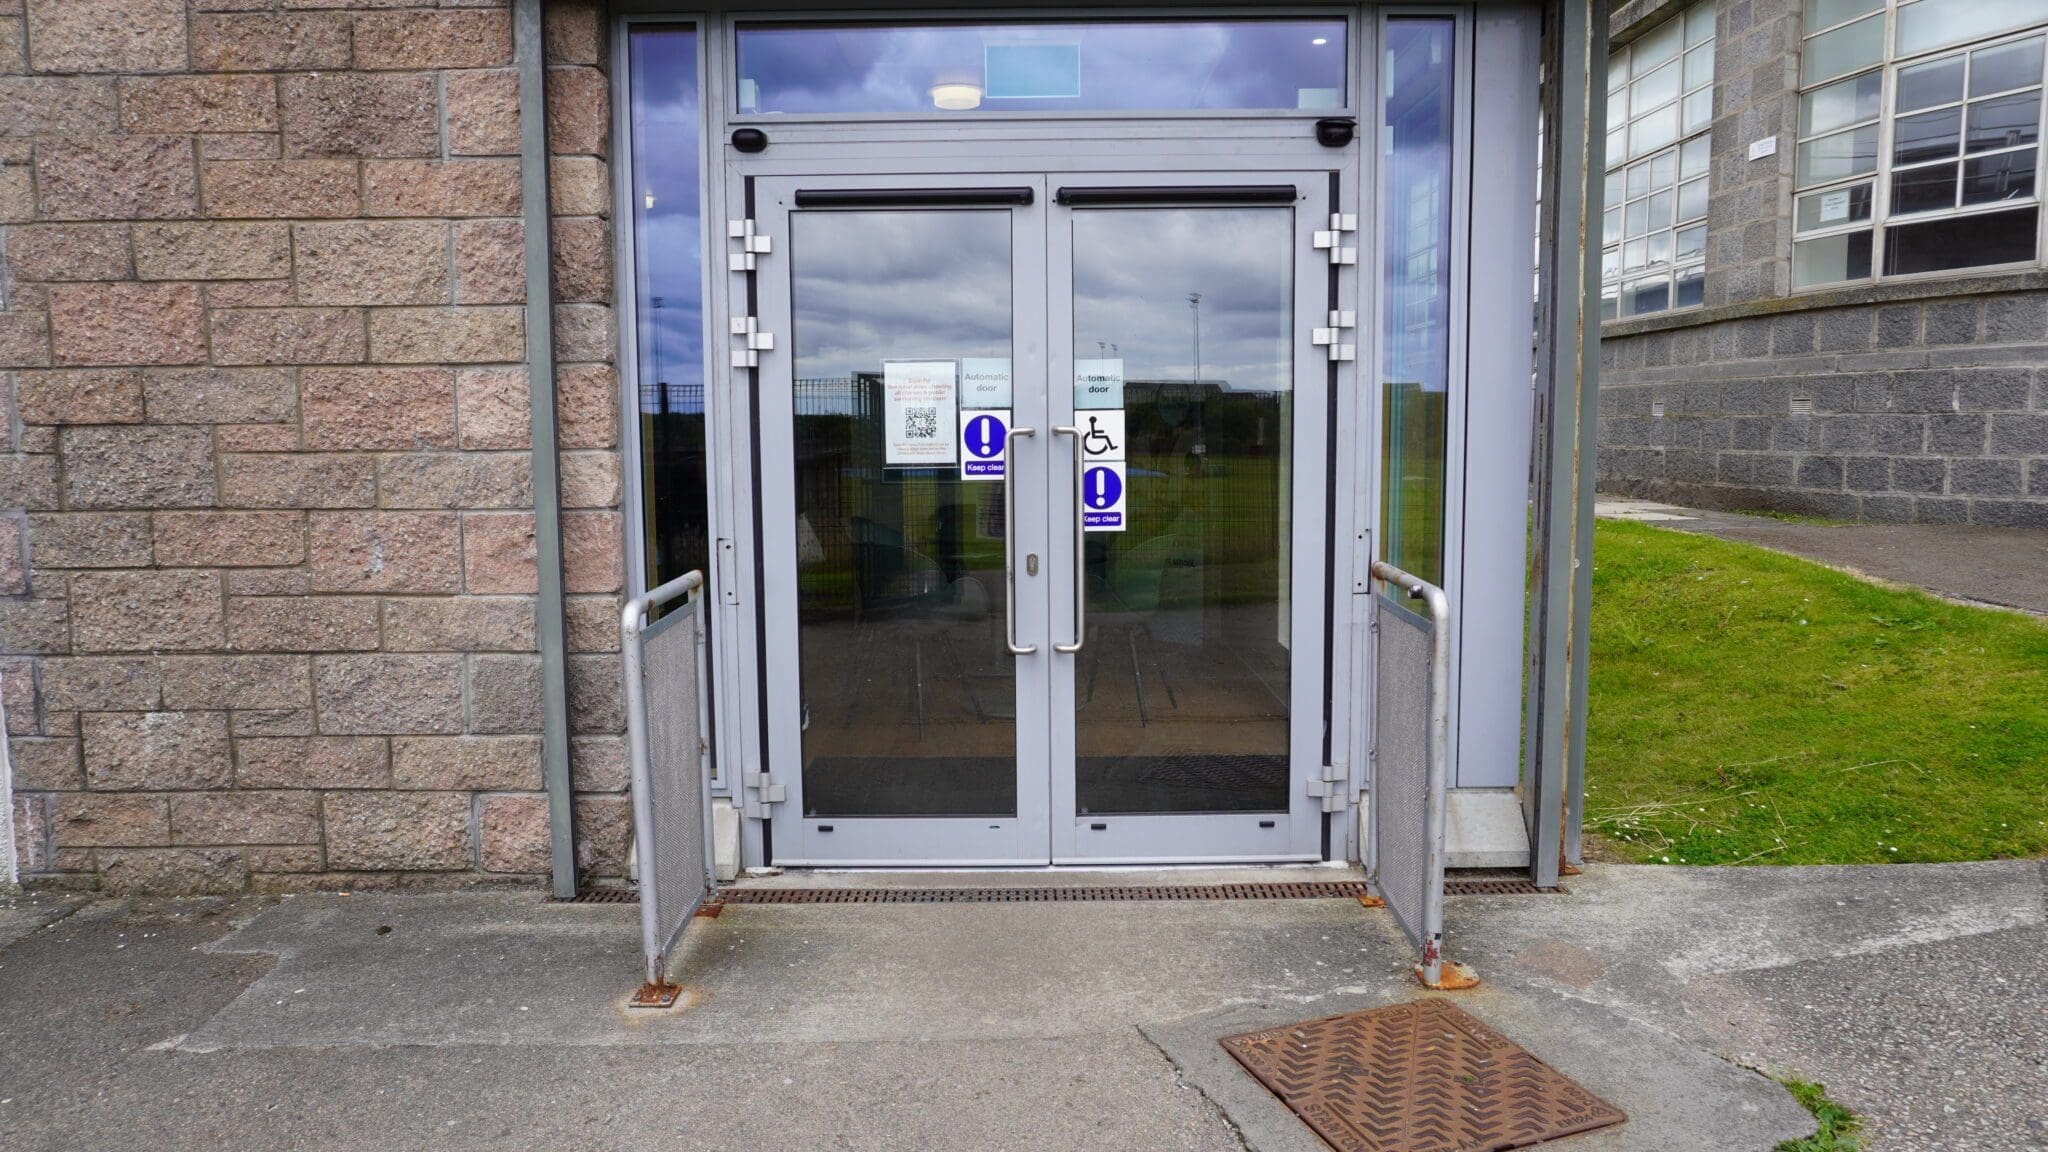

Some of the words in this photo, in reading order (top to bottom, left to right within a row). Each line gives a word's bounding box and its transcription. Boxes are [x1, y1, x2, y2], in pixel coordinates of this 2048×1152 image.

[964, 373, 1009, 381] Automatic
[1077, 374, 1121, 382] Automatic
[976, 384, 997, 392] door
[967, 463, 986, 473] Keep
[987, 463, 1005, 471] clear
[1102, 514, 1120, 522] clear
